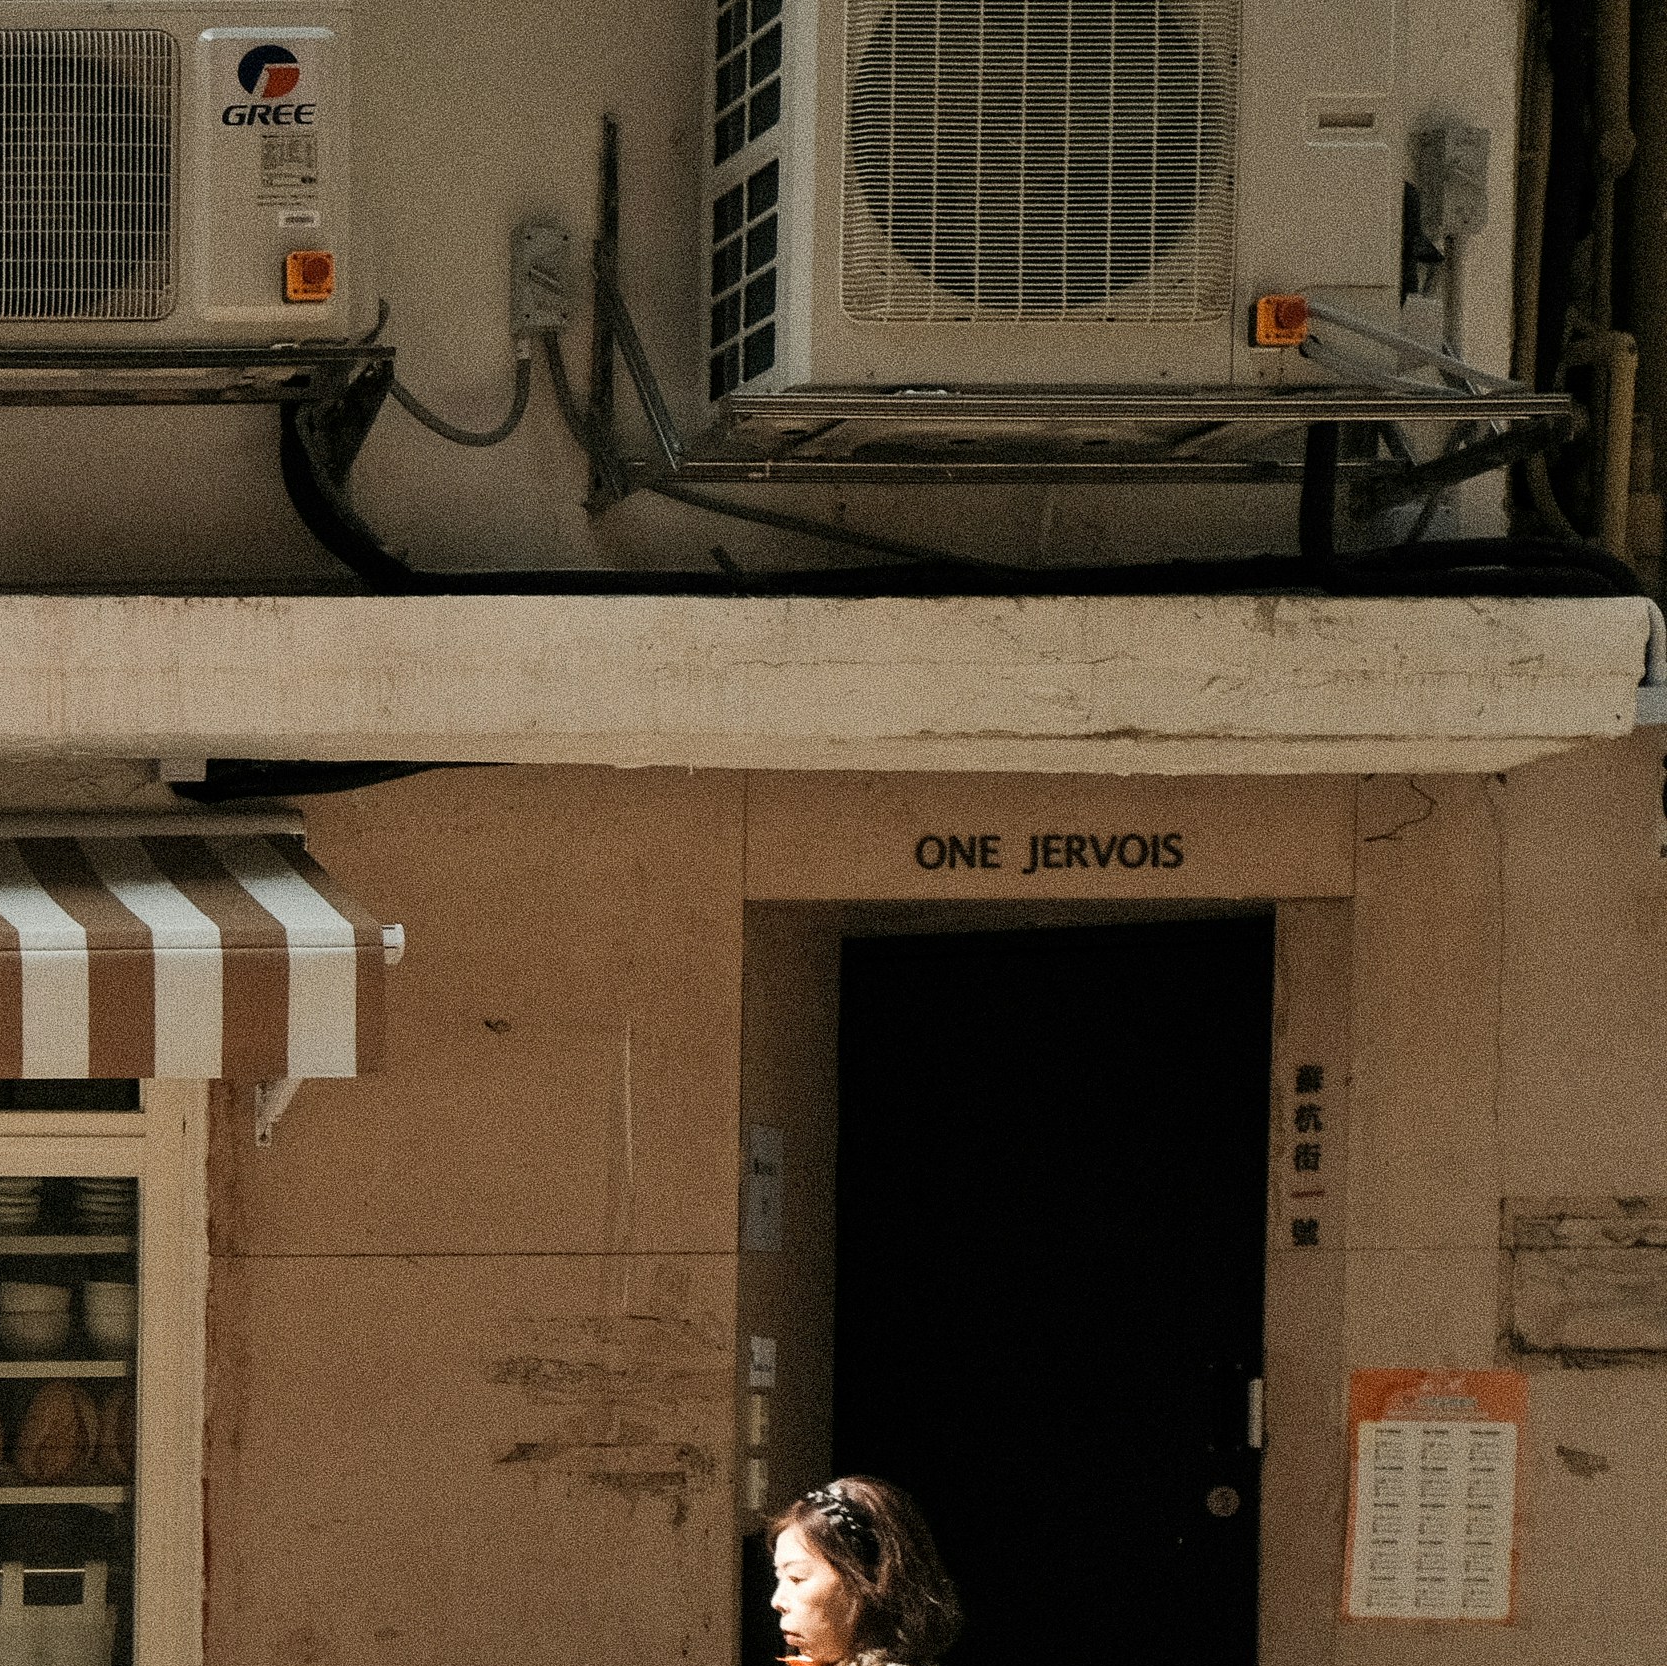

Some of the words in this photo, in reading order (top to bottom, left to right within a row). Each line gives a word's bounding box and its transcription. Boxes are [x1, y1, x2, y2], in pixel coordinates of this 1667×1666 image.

[221, 103, 317, 126] GREE
[916, 834, 1002, 870] ONE
[1021, 832, 1185, 875] JERVOIS
